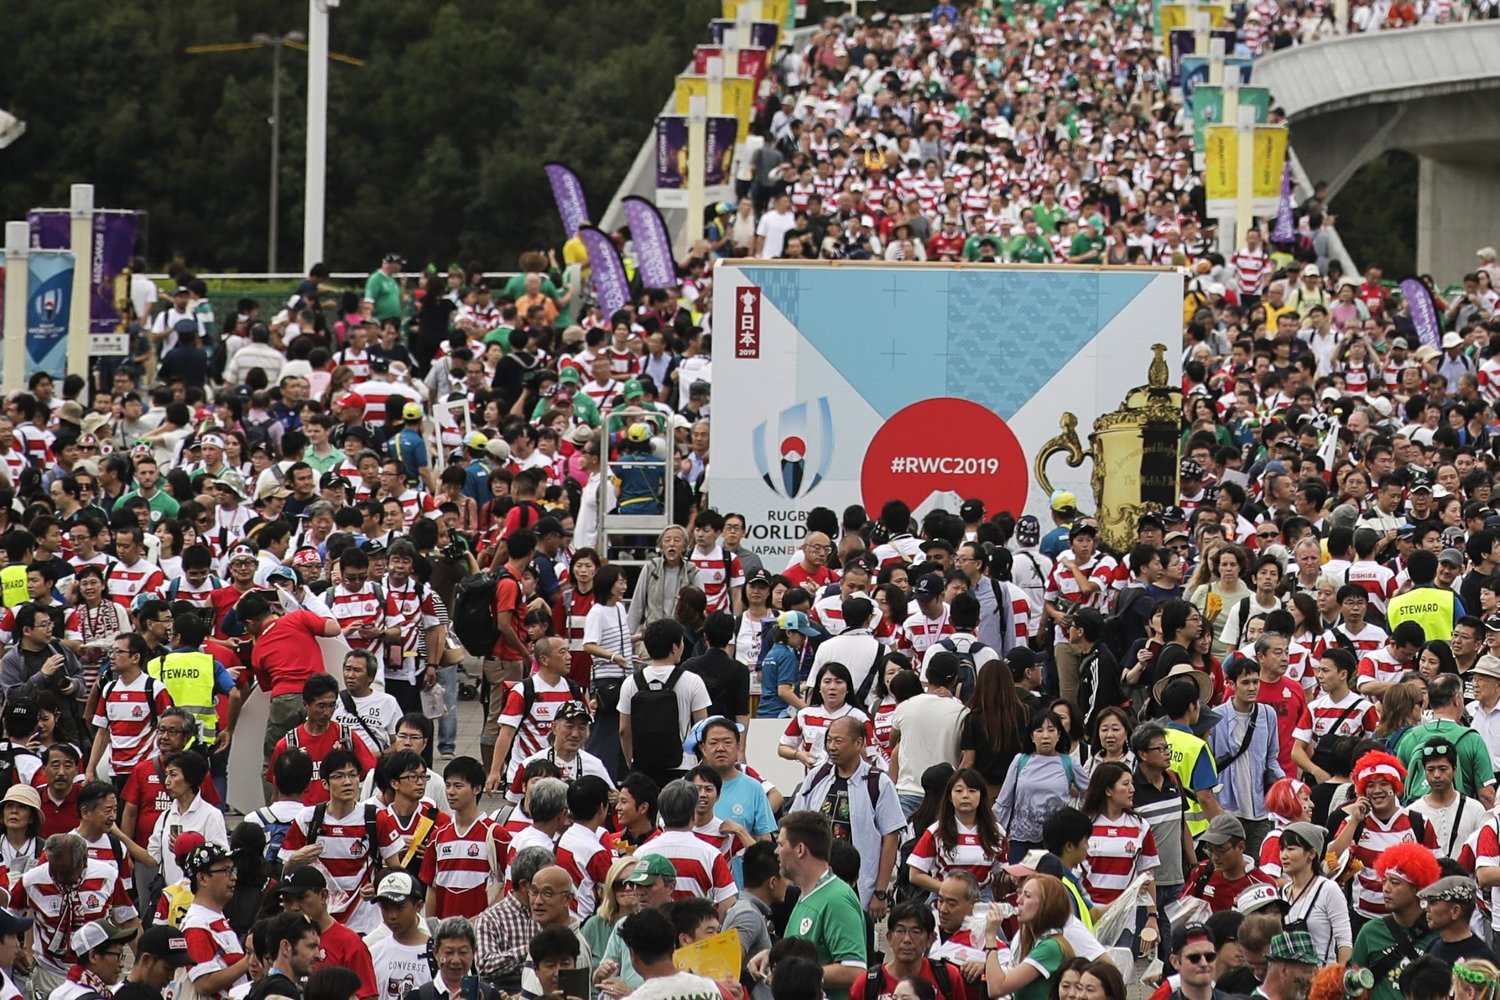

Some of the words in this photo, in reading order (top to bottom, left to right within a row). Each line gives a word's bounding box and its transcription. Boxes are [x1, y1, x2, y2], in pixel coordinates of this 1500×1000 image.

[739, 315, 756, 348] 日本
[739, 349, 756, 357] 2019
[890, 456, 1000, 477] #RWC2019
[1399, 603, 1439, 616] STEWARD
[162, 668, 200, 679] TEWARD
[388, 961, 426, 973] CONVERSE
